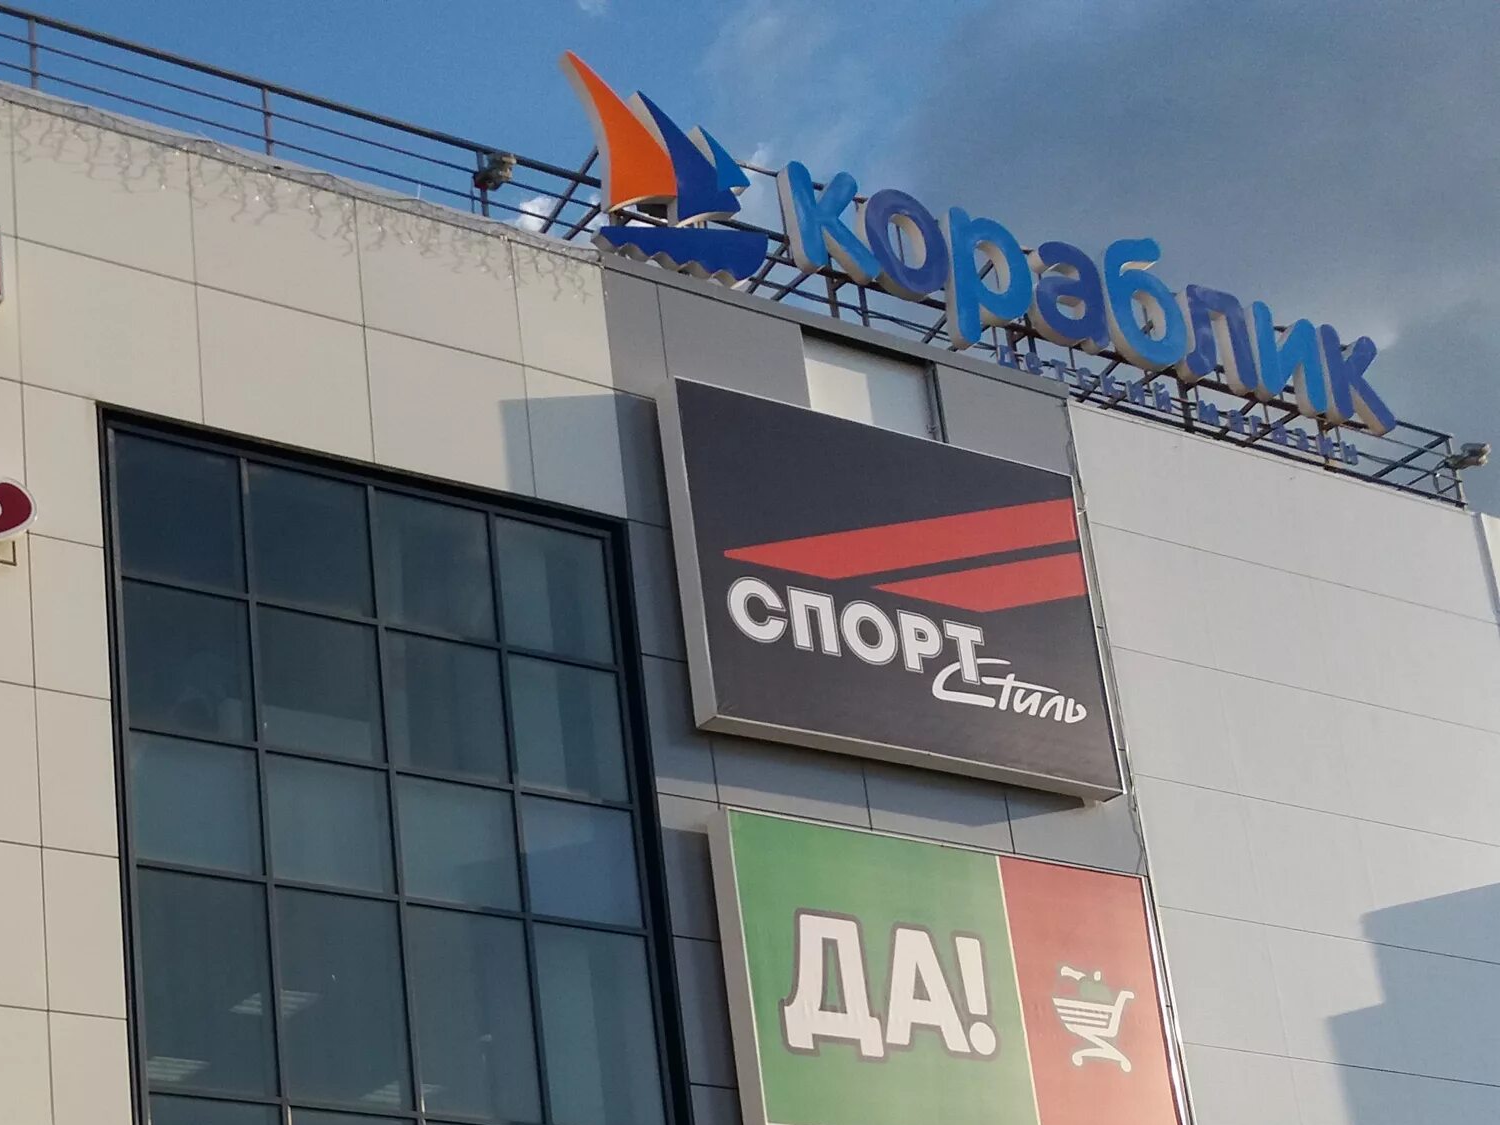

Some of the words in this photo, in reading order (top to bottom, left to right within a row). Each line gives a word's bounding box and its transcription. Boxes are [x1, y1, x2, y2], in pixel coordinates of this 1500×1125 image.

[776, 160, 1396, 436] кораблик
[727, 576, 985, 684] СПОРТ
[932, 657, 1088, 723] Стиль
[781, 910, 998, 1061] ДА!
